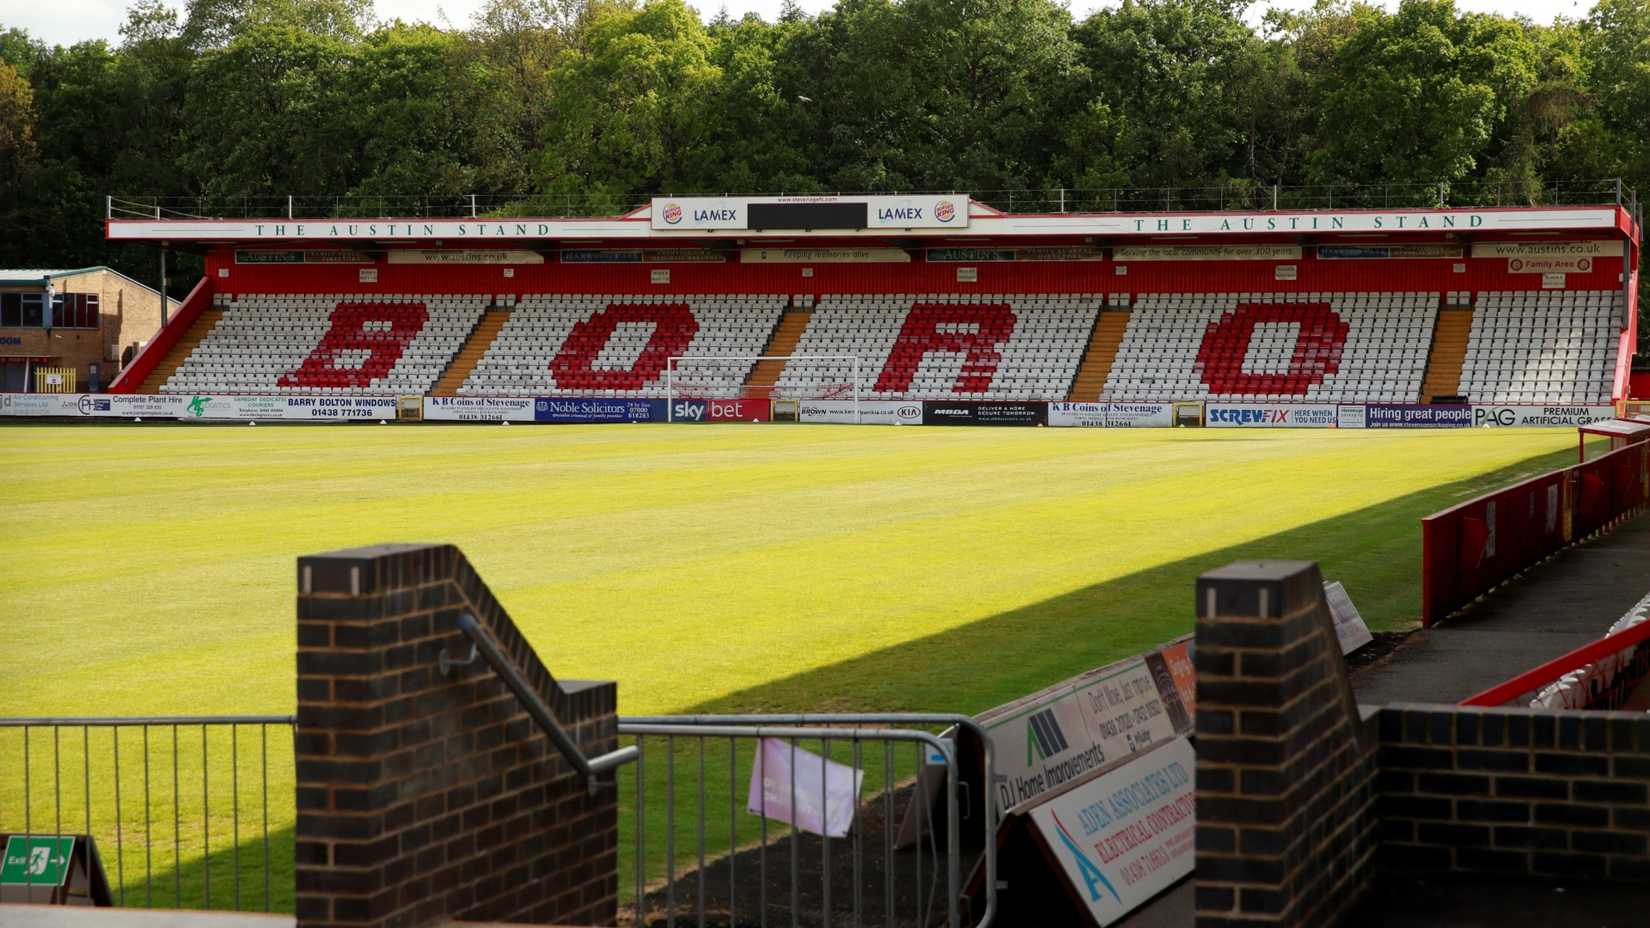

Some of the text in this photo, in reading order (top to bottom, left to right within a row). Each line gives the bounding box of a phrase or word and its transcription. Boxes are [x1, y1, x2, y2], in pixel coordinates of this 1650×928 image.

[694, 209, 737, 221] LAMEX
[878, 208, 922, 219] LAMEX
[1134, 214, 1483, 231] THE AUSTIN STAND
[255, 224, 549, 237] THE AUSTIN STAND
[1495, 244, 1600, 255] www.austins.co.uk
[112, 396, 146, 405] Complete
[148, 396, 167, 404] Plant
[288, 399, 397, 407] BARRY BOLTON WINDOWS
[432, 397, 530, 408] K B Coins of Stevenage
[550, 401, 625, 413] Noble Solicitors
[675, 401, 705, 421] sky
[711, 401, 743, 417] bet
[1052, 403, 1163, 414] K B Coins of Stevenage
[1543, 407, 1589, 416] PREMIUM
[1210, 409, 1289, 425] SCREWFIX
[1369, 407, 1402, 421] Hiring
[1404, 408, 1432, 420] great
[1434, 408, 1472, 421] people
[1475, 408, 1515, 426] PAG
[1521, 416, 1574, 425] ARTIFICIAL
[1016, 775, 1045, 803] Home
[1043, 741, 1105, 788] Improvements
[1077, 761, 1189, 836] ADEN ASSOCIATES LTD
[1093, 819, 1153, 864] ELECTRICAL
[8, 856, 26, 864] Exit
